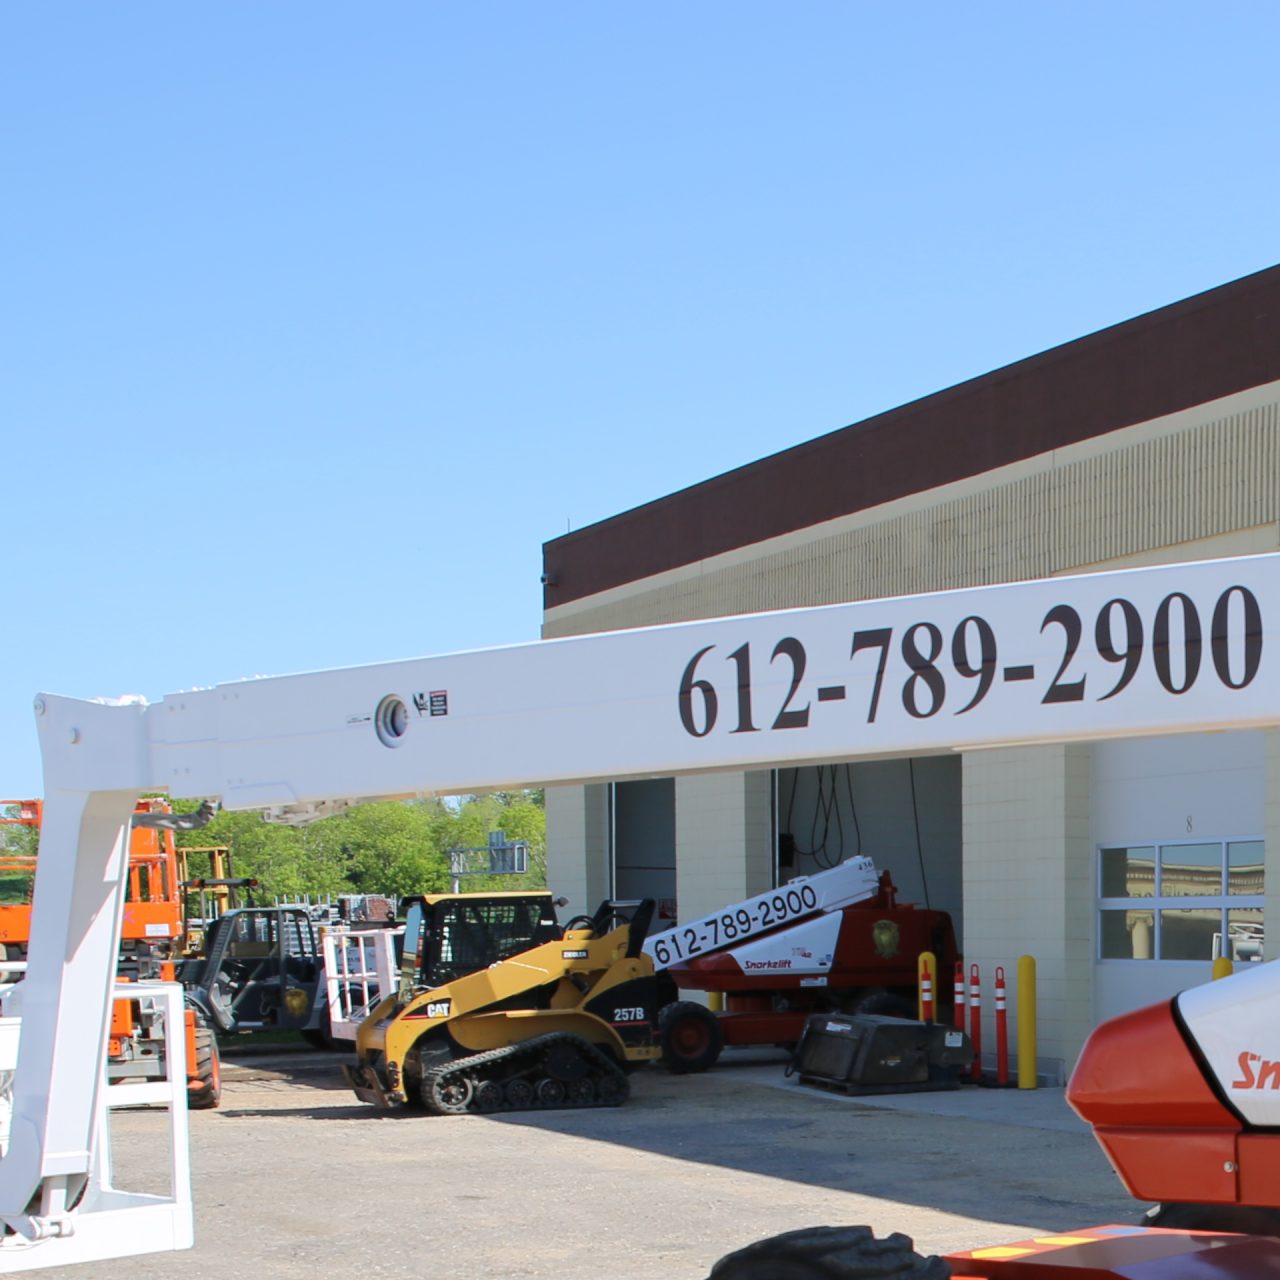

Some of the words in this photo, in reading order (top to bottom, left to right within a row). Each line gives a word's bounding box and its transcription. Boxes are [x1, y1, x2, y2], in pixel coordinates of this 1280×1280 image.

[678, 585, 1263, 738] 612-789-2900
[1186, 815, 1193, 833] 8
[654, 885, 816, 964] 612-789-2900
[427, 1003, 449, 1018] CAT
[614, 1007, 644, 1021] 257B
